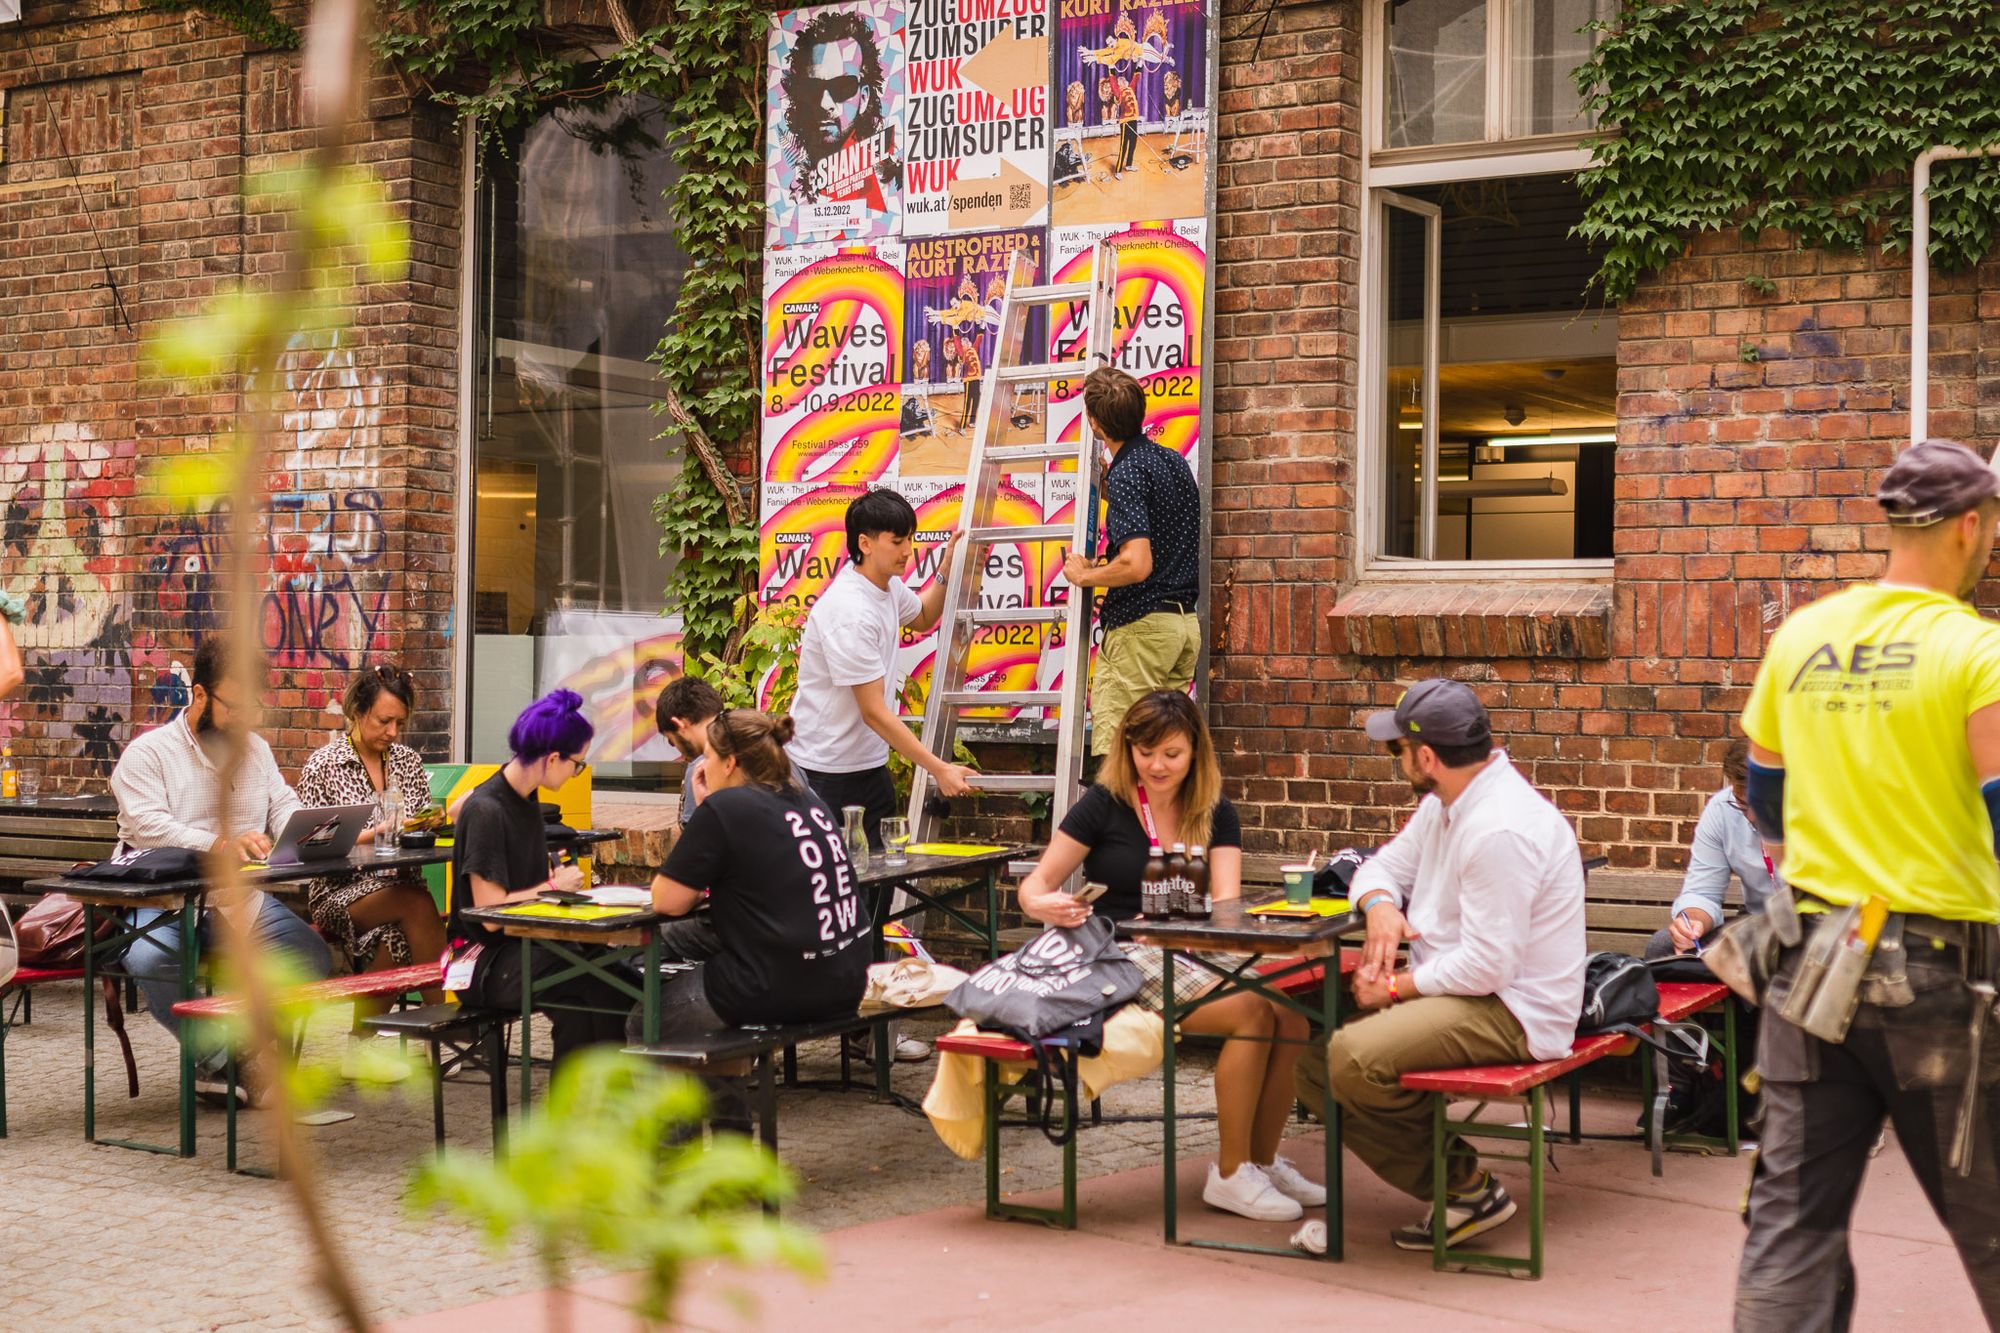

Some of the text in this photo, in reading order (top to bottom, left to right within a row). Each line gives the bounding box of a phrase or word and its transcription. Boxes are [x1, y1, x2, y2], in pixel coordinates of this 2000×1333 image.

[908, 57, 963, 94] WUK
[907, 117, 1045, 162] ZUMSUPER
[817, 131, 890, 189] SHANTEL
[907, 158, 962, 194] WUK
[907, 191, 1002, 213] wuk.at/spenden
[814, 205, 851, 217] 13.12.2022
[1060, 232, 1079, 241] WUK
[1087, 231, 1101, 240] The
[1127, 228, 1150, 238] Clash
[1157, 227, 1177, 236] WUK
[1180, 225, 1200, 235] Beisl
[907, 233, 1041, 261] AUSTROFRED &
[1164, 239, 1199, 249] Chelsea
[775, 256, 792, 265] WUK
[800, 255, 812, 264] The
[861, 252, 880, 260] WUK
[883, 250, 900, 260] Beisl
[775, 263, 899, 277] FaniaLive Weberknecht Chelsea
[907, 257, 956, 279] KURT
[784, 304, 819, 314] CANAL+
[783, 319, 886, 349] Waves
[772, 353, 895, 387] Festival
[792, 439, 869, 449] Festival Pass €59
[767, 486, 784, 494] WUK
[792, 485, 804, 494] The
[904, 481, 961, 491] WUK The Loft
[1018, 479, 1036, 488] Beisl
[1051, 480, 1070, 488] WUK
[1004, 492, 1036, 502] Chelsea
[776, 534, 812, 543] CANAL+
[914, 532, 951, 541] CANAL+
[1787, 642, 1918, 693] AES
[784, 811, 835, 941] 2022
[809, 807, 857, 932] CREW
